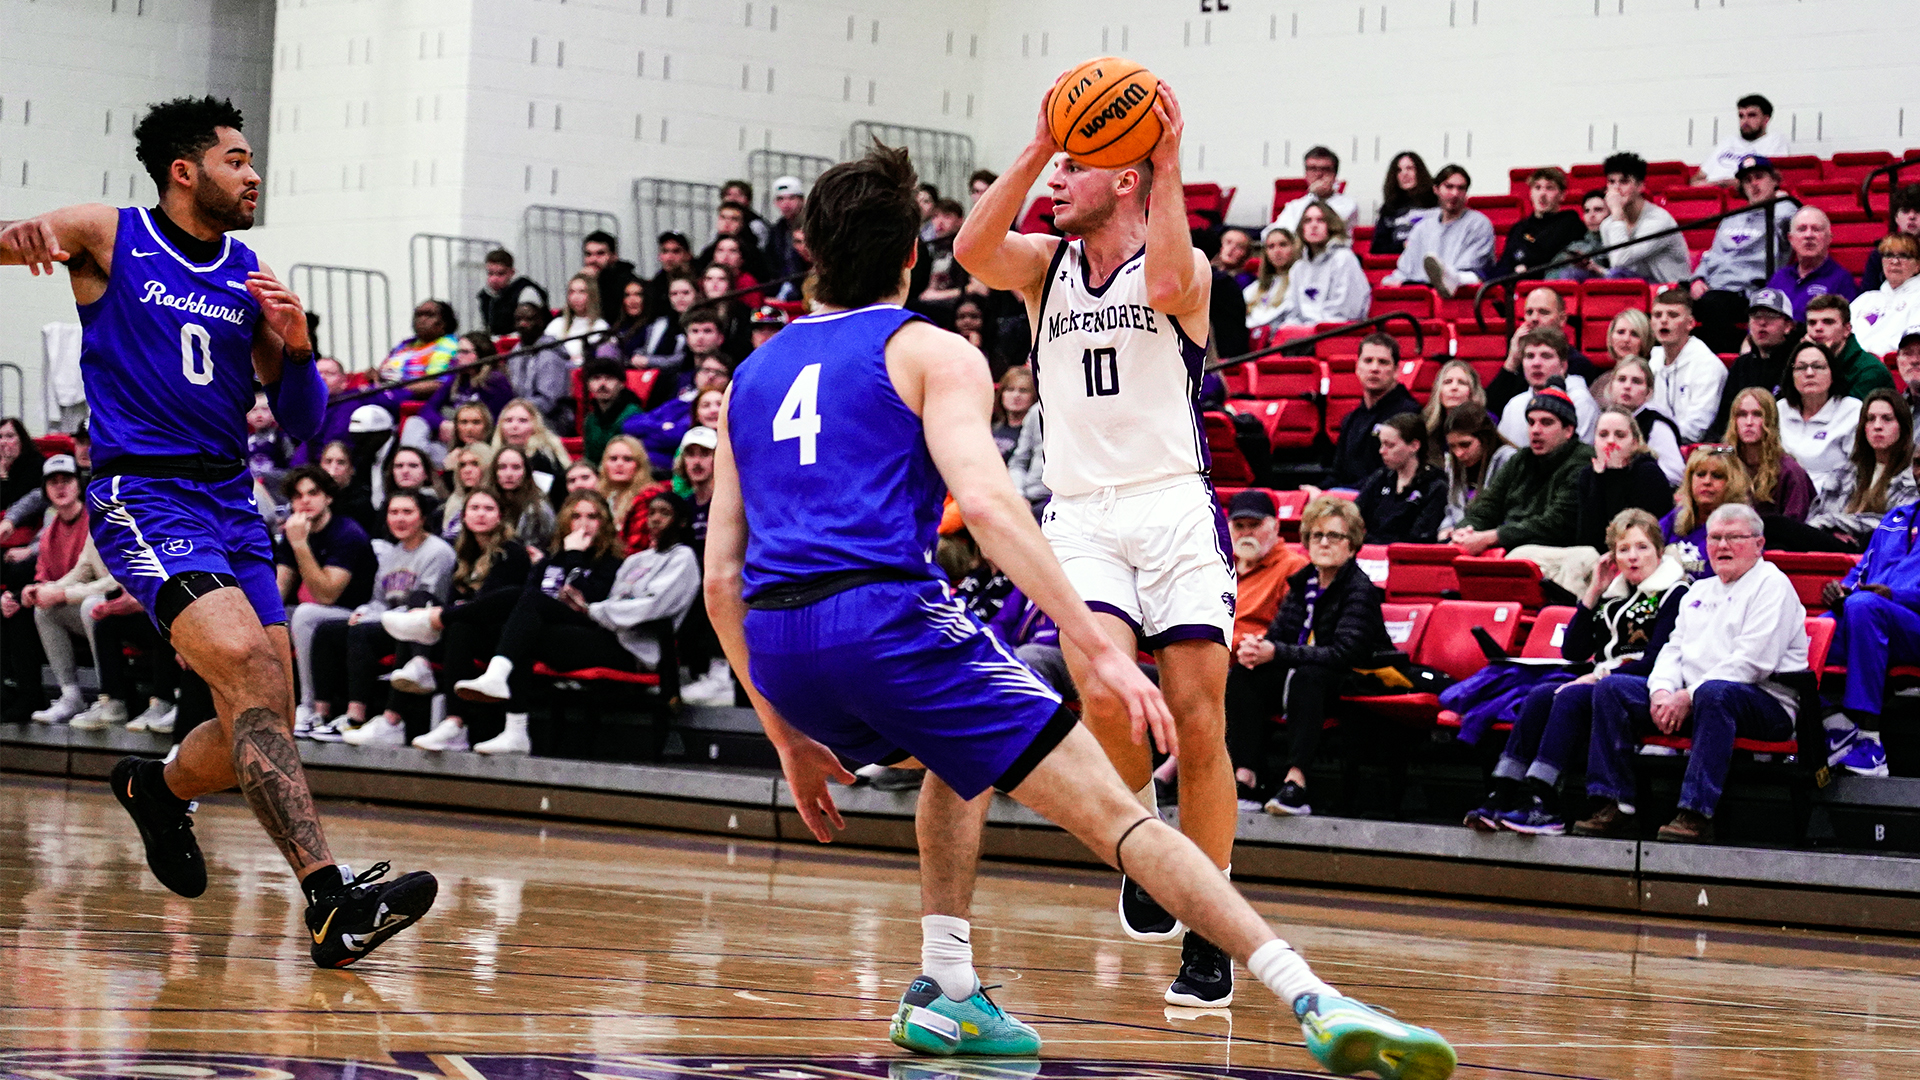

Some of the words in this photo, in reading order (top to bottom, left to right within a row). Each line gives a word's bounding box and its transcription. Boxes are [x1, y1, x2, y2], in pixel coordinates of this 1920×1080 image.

[1079, 83, 1149, 138] Wilson
[139, 280, 245, 325] Rockhurst
[181, 322, 214, 386] 0
[1082, 347, 1120, 397] 10
[772, 362, 821, 466] 4
[1874, 824, 1885, 842] B
[910, 979, 932, 993] GT
